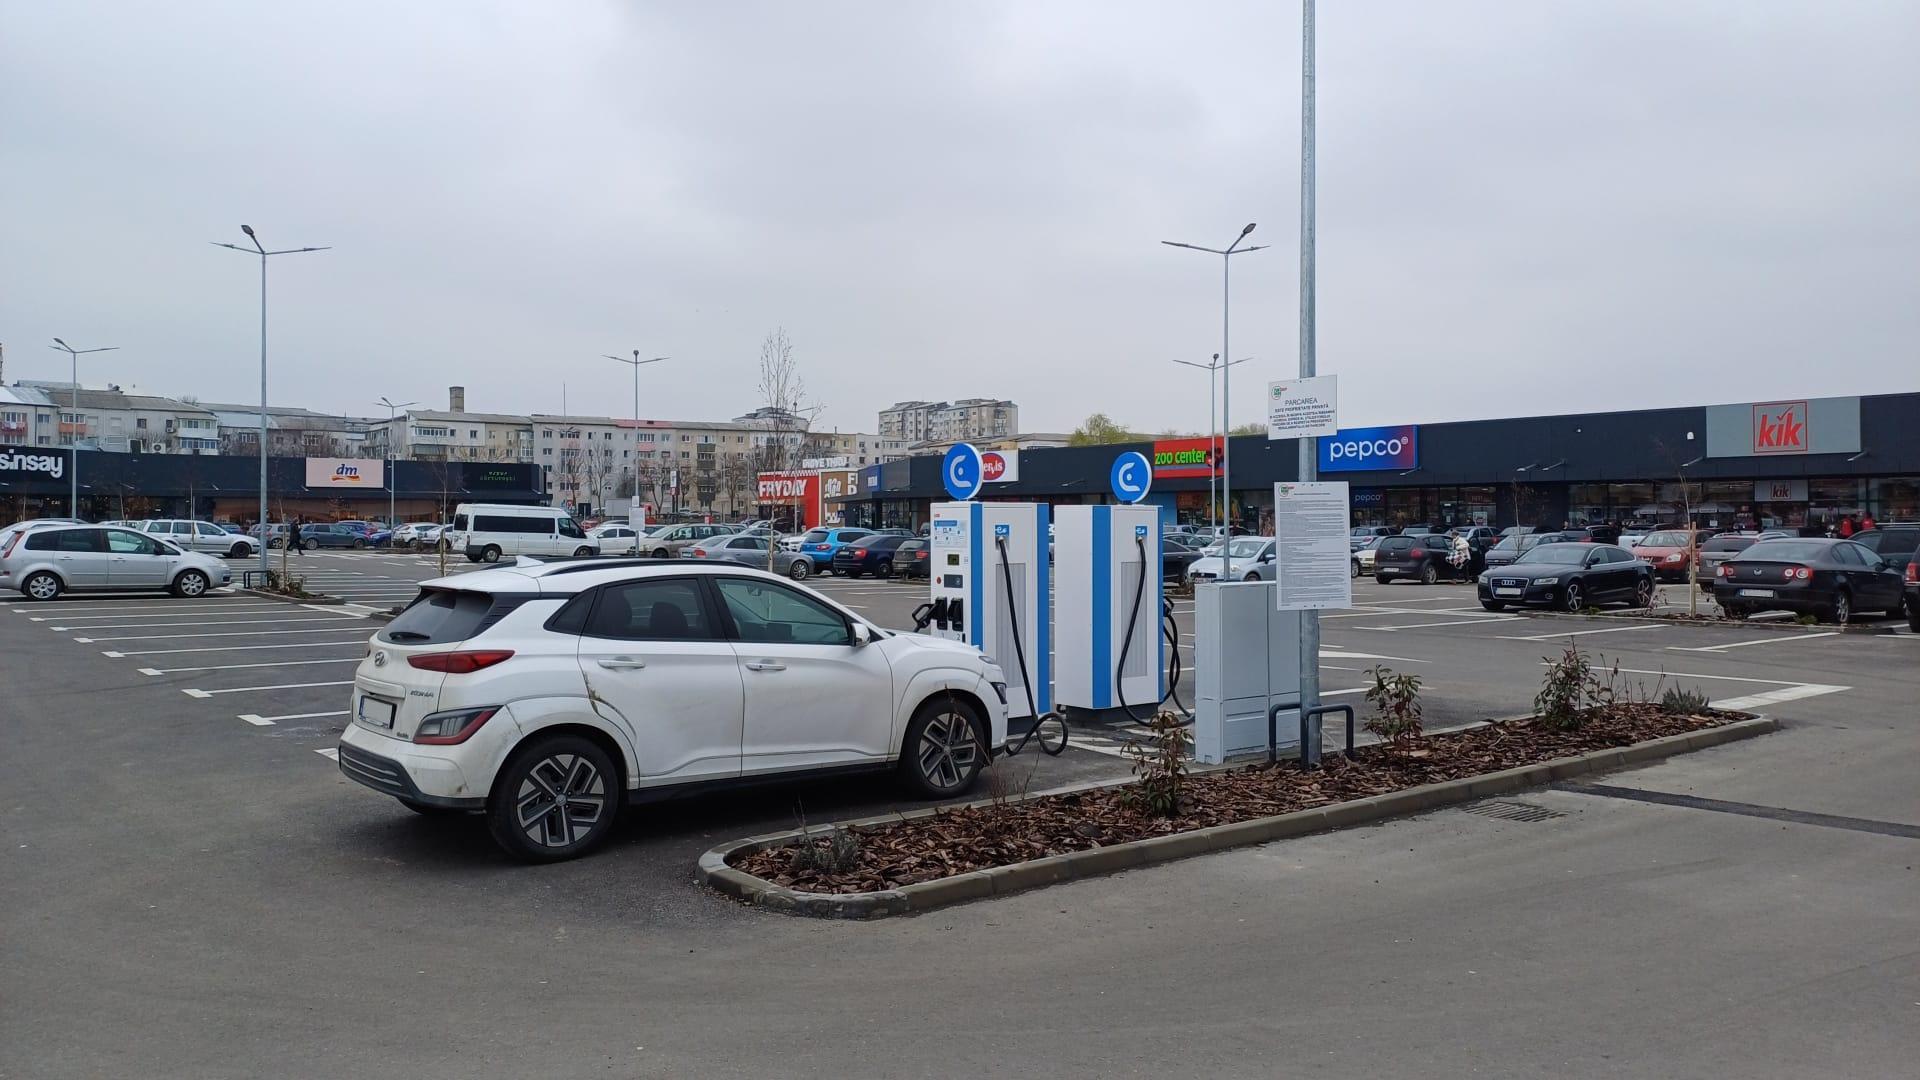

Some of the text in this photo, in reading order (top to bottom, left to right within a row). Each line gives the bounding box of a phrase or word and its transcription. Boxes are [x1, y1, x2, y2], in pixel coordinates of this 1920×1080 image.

[1285, 397, 1318, 405] PARCAREA
[1758, 407, 1802, 448] kik
[1155, 448, 1206, 464] zoo center
[1330, 439, 1402, 462] pepco
[0, 449, 63, 478] sinsay
[336, 464, 358, 475] dm
[983, 460, 1003, 474] ervis
[758, 479, 807, 497] FRYDAY
[1355, 494, 1381, 502] pepco
